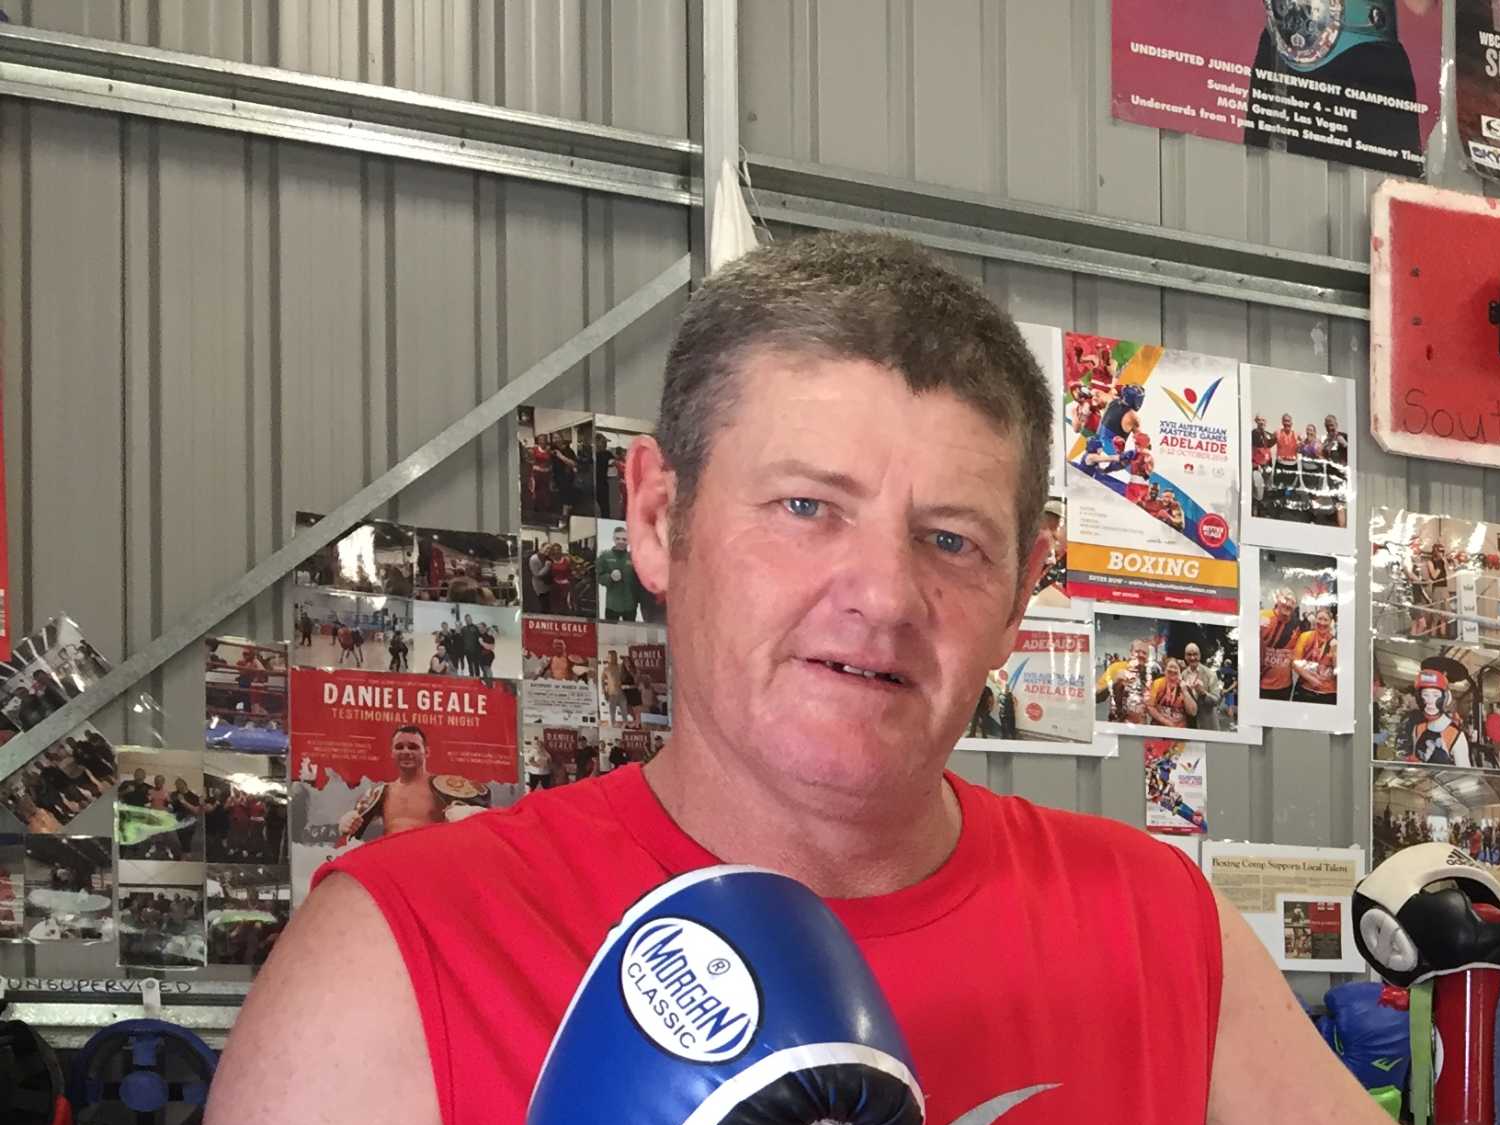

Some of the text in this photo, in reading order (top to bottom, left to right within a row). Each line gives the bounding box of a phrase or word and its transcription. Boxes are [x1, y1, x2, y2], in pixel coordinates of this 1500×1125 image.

[1130, 42, 1429, 114] UNDISPUTED JUNIOR WELTERWEIGHT CHAMPIONSHIP
[1207, 79, 1249, 98] Sunday
[1252, 88, 1310, 110] November
[1312, 102, 1322, 112] 4
[1333, 106, 1358, 120] LIVE
[1216, 96, 1349, 132] MGM Grand, Las Vegas
[1131, 94, 1427, 164] Undercards from 1pm Eastern Standard Summer Time
[1160, 435, 1228, 454] ADELAIDE
[1107, 551, 1200, 578] BOXING
[528, 620, 588, 633] DANIEL GEALE
[323, 682, 409, 710] DANIEL
[416, 689, 488, 715] GEALE
[332, 707, 481, 727] TESTIMONIAL FIGHT NIGHT
[1212, 857, 1241, 869] Boxing
[1268, 860, 1301, 871] Supports
[1302, 861, 1322, 871] Local
[1324, 863, 1348, 873] Talent
[8, 977, 192, 994] UNSUPERVED
[641, 927, 748, 1042] MORGAN
[627, 961, 697, 1049] CLASSIC
